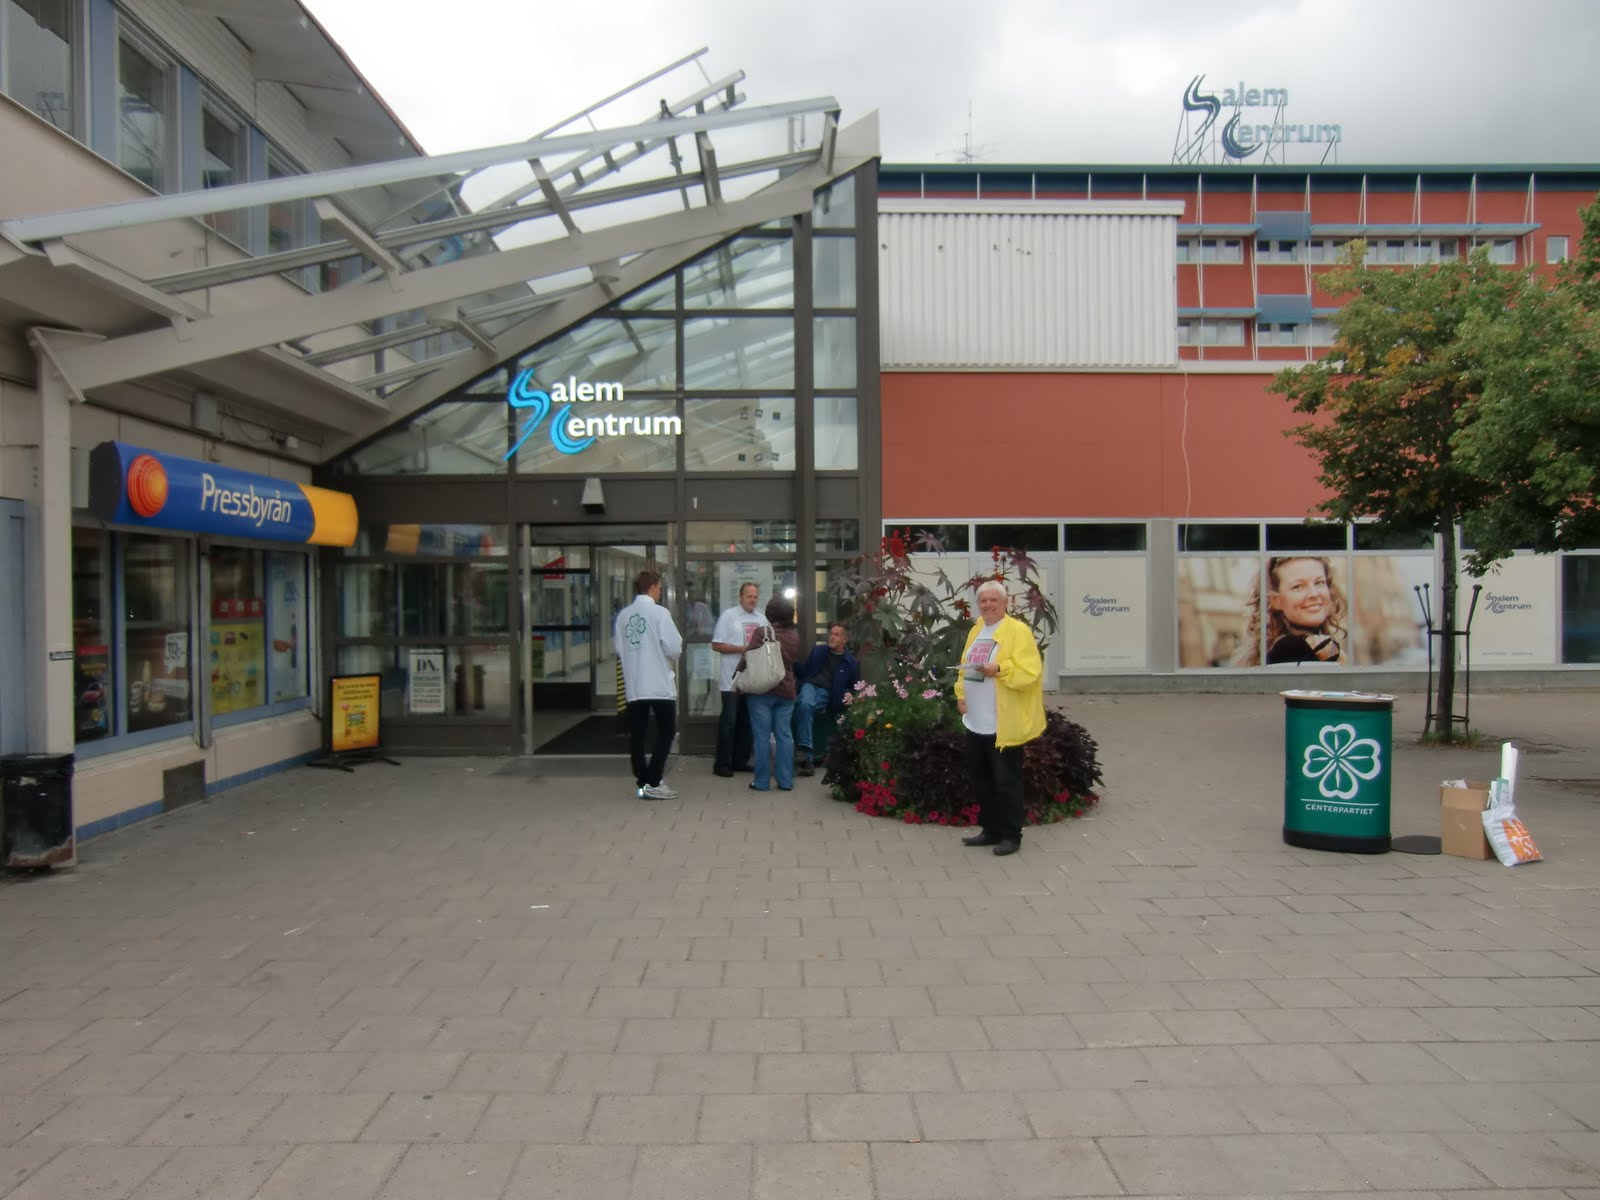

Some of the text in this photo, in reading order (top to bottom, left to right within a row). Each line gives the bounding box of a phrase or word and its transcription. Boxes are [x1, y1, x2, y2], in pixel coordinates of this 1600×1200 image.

[1179, 73, 1289, 160] Salem
[1222, 112, 1342, 159] Centrum
[503, 368, 624, 461] Salem
[551, 404, 682, 455] Centrum
[200, 472, 292, 528] Pressbyrån
[1082, 594, 1117, 613] Salem
[1090, 604, 1130, 616] Centrum
[1485, 592, 1519, 610] Salem
[1492, 602, 1532, 614] Centrum
[1305, 803, 1375, 815] CENTERPARTIET
